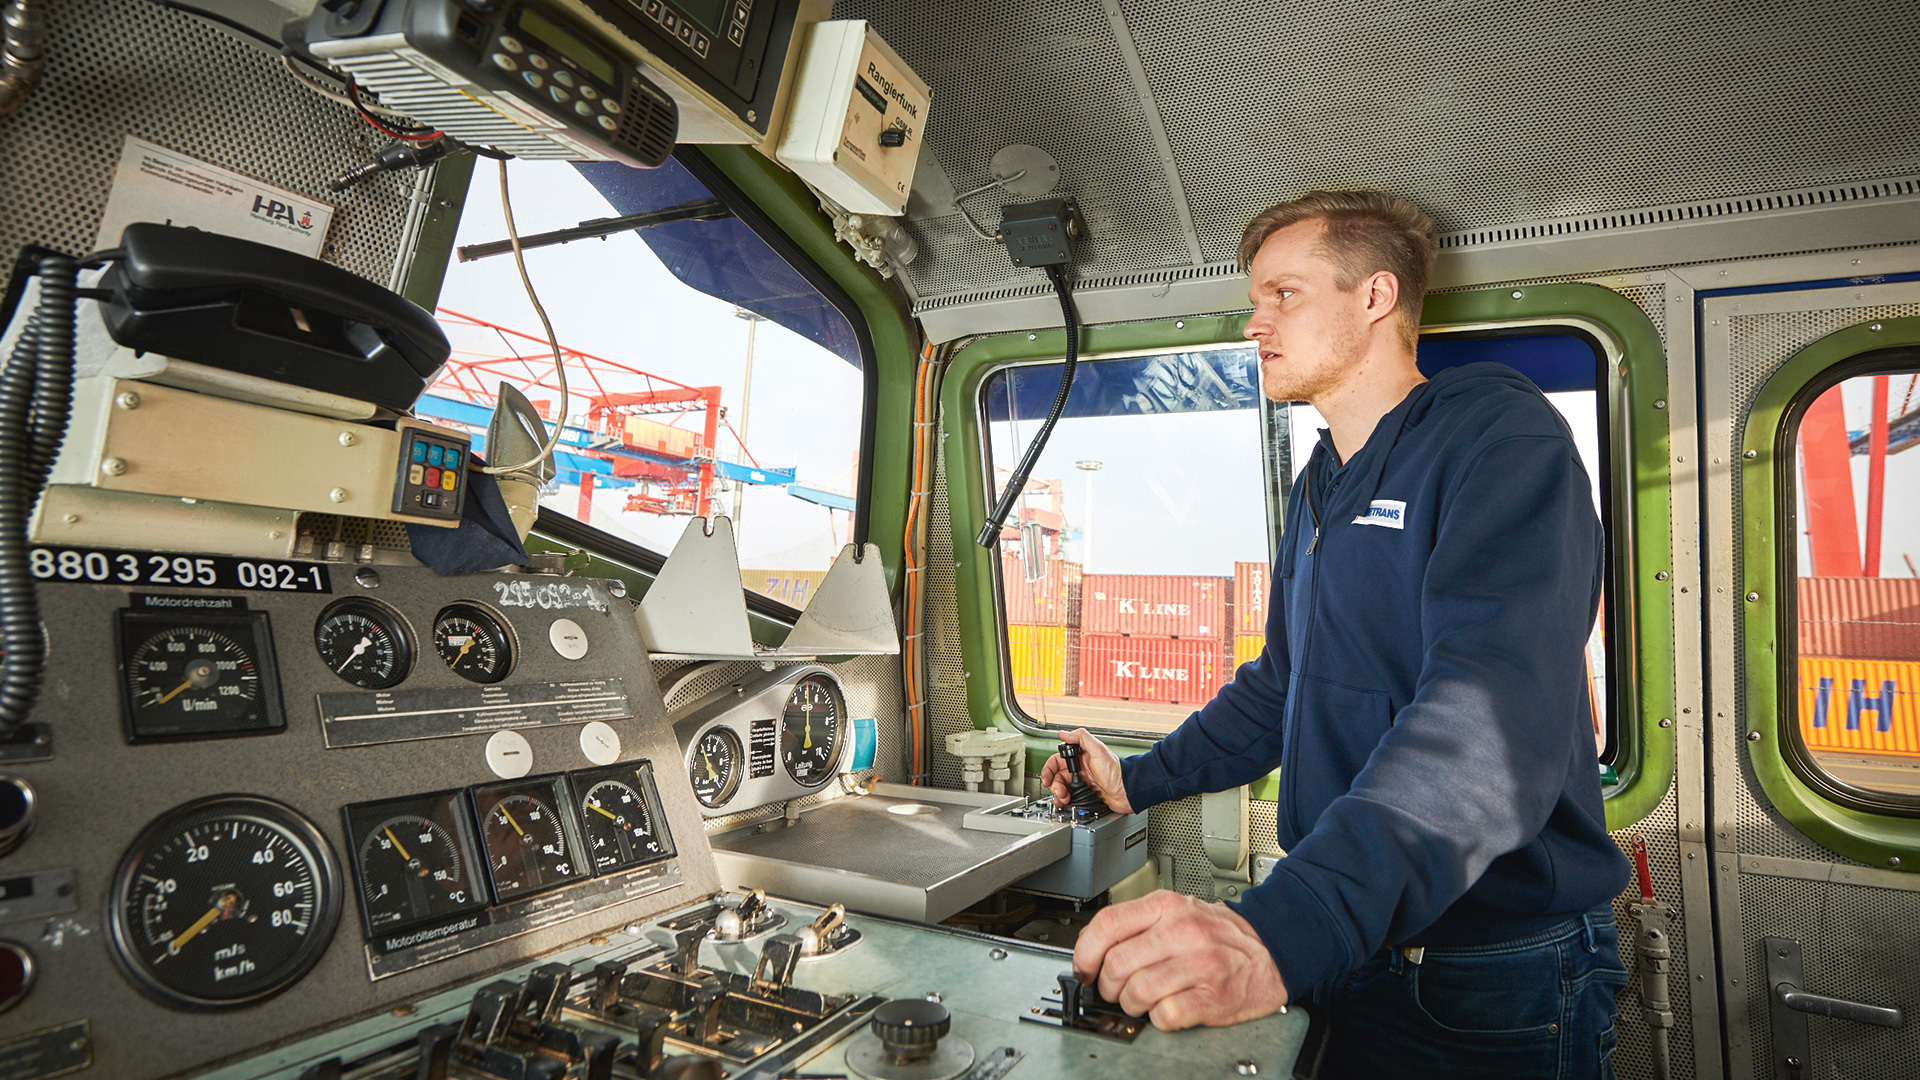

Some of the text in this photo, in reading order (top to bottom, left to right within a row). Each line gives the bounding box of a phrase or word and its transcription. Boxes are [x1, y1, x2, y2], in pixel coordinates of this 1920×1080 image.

[640, 83, 670, 107] MOTOROLA
[868, 61, 918, 119] Rangierfunk
[252, 195, 295, 225] HPA
[250, 212, 312, 237] Hamburg Port Authority
[413, 446, 422, 456] 55
[430, 451, 438, 460] 70
[446, 454, 454, 462] 85
[1367, 508, 1400, 520] ETRANS
[115, 554, 139, 582] 3
[148, 556, 217, 585] 295
[237, 562, 322, 590] 092-1
[1252, 570, 1263, 611] TRITON
[145, 597, 232, 608] Motordrehzahl
[1143, 603, 1190, 616] LINE
[1140, 666, 1188, 681] LINE
[182, 698, 217, 711] U/min
[1812, 677, 1896, 732] IH
[795, 760, 812, 770] Leitung
[498, 815, 508, 825] 50
[529, 811, 541, 821] 100
[380, 839, 391, 849] 50
[418, 832, 432, 844] 100
[543, 845, 554, 854] 150
[646, 841, 658, 852] °C
[186, 845, 209, 863] 20
[252, 849, 274, 865] 40
[433, 870, 447, 881] 150
[556, 863, 570, 875] °C
[155, 879, 177, 894] 10
[273, 880, 294, 897] 60
[449, 890, 465, 903] °C
[272, 909, 292, 927] 80
[386, 916, 477, 951] Motoröltemperatur
[214, 944, 246, 961] m/s
[214, 960, 255, 981] km/h
